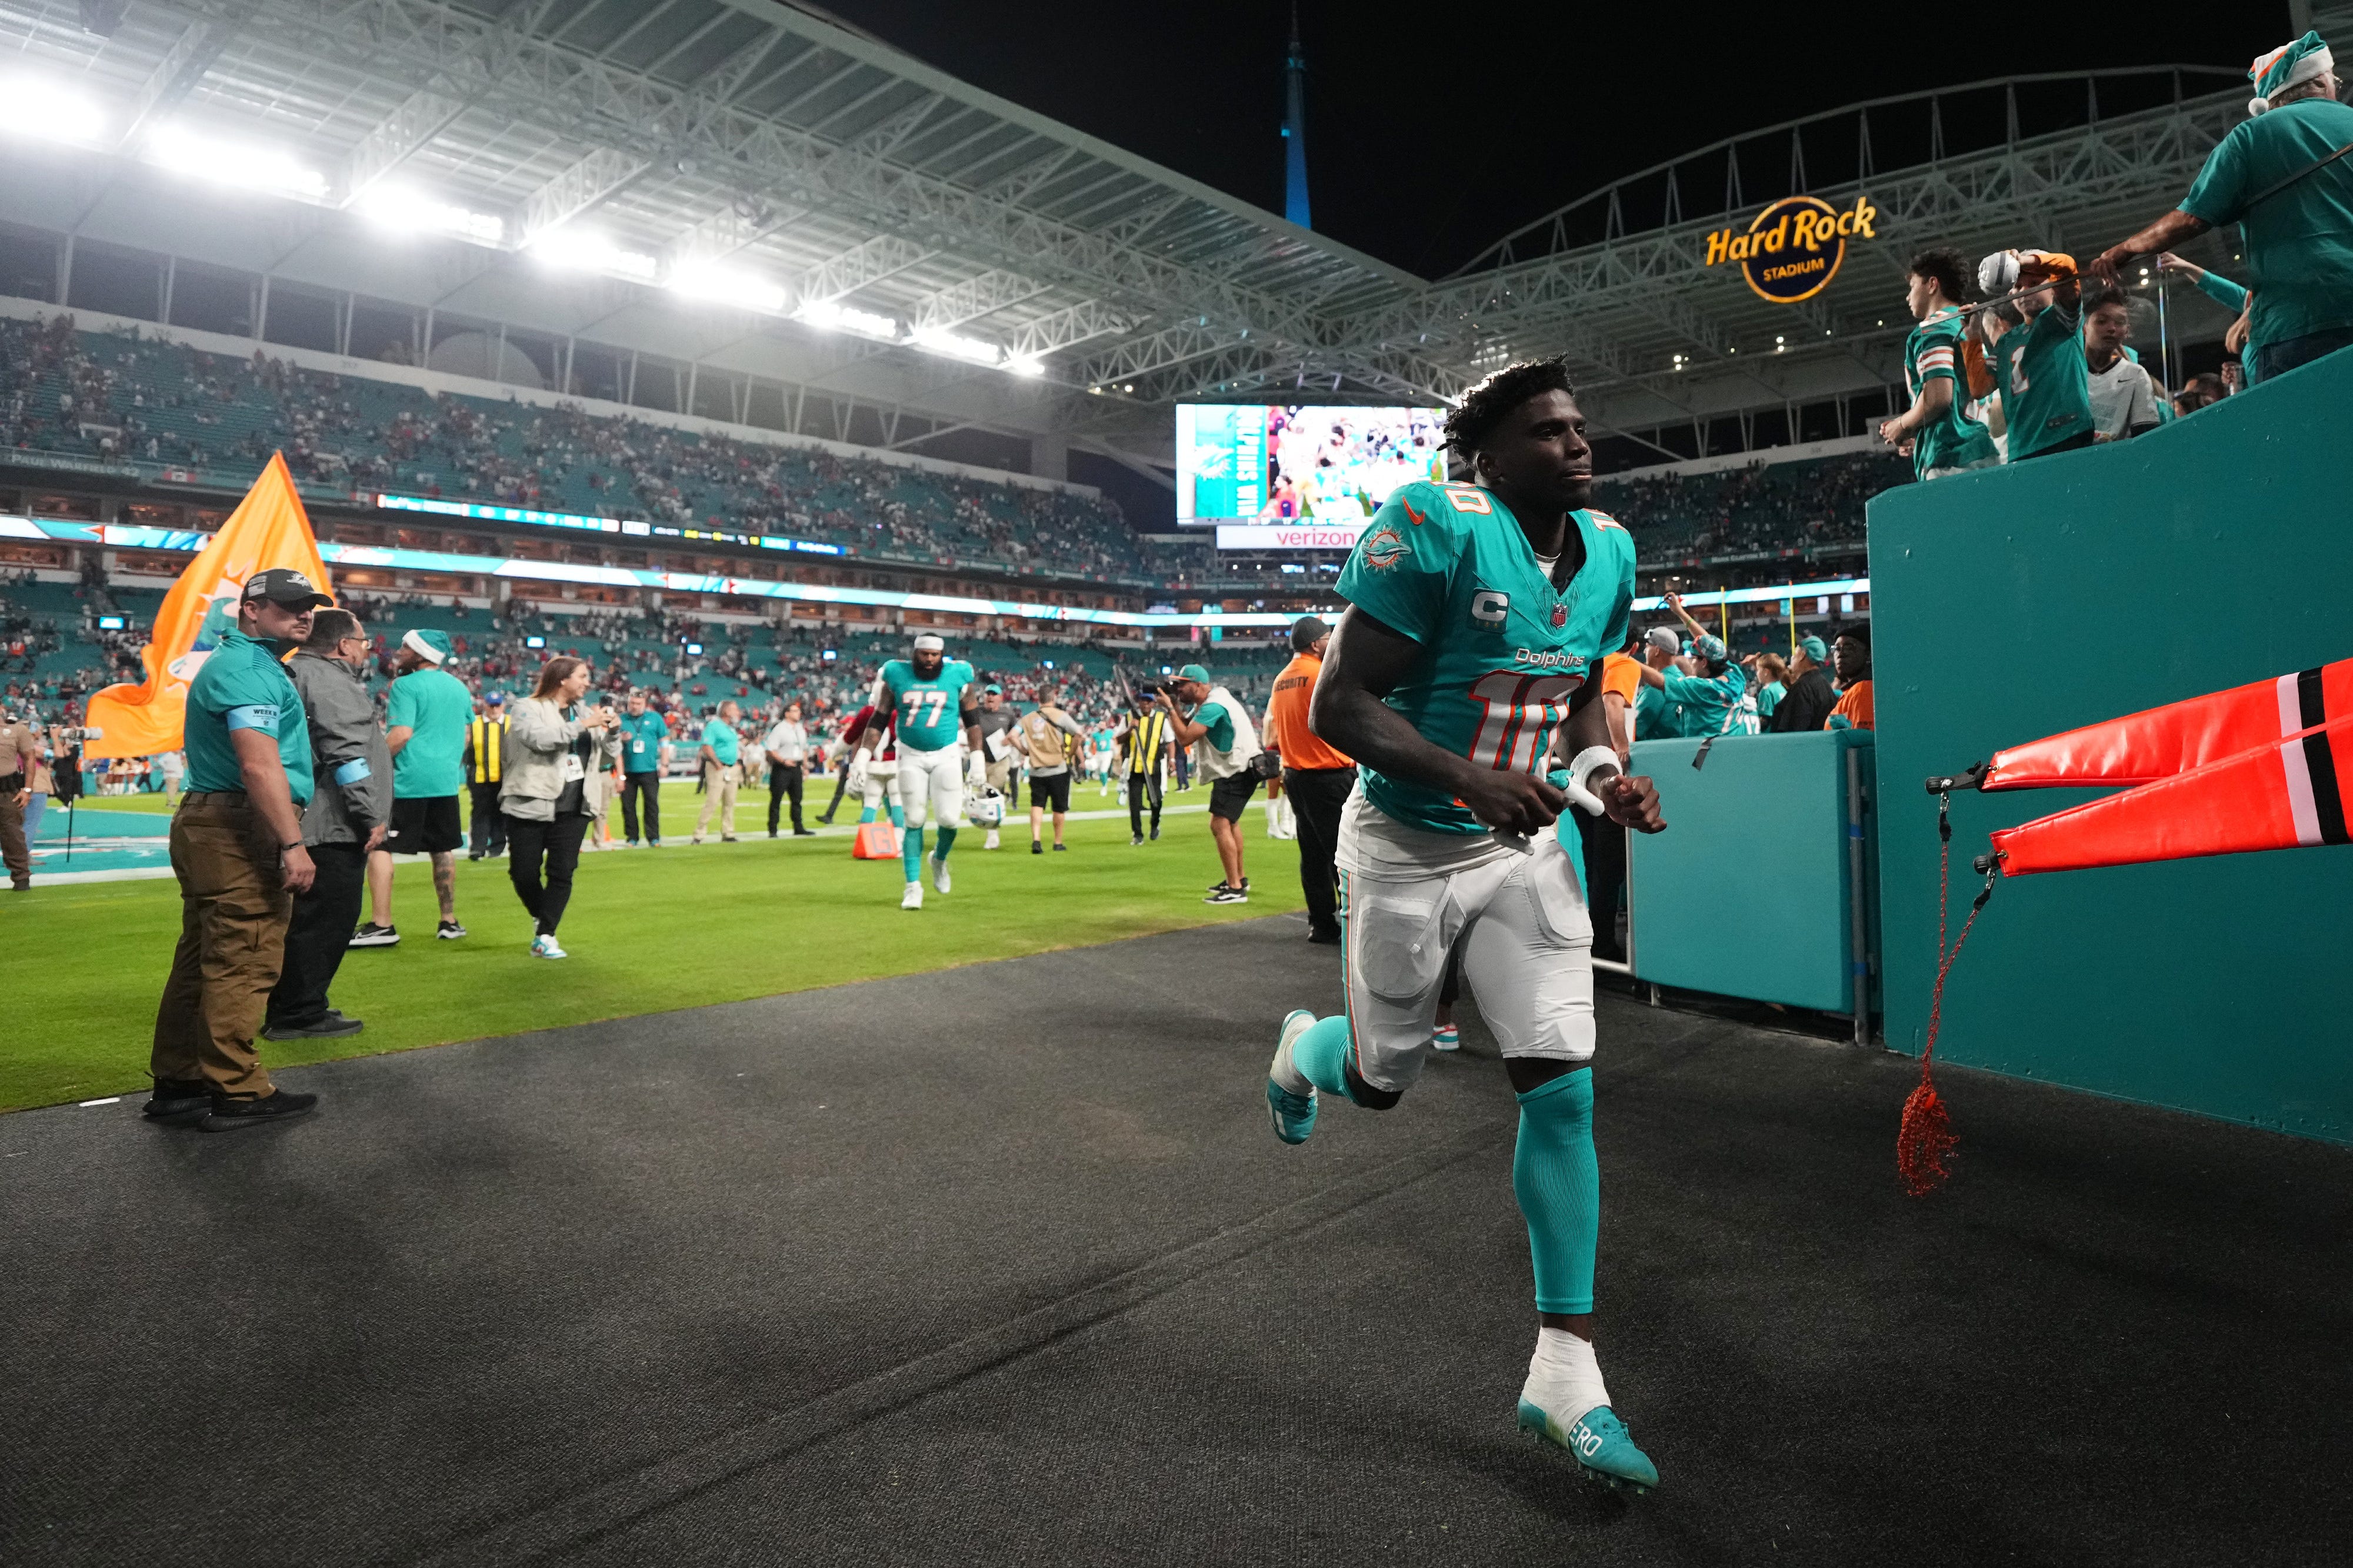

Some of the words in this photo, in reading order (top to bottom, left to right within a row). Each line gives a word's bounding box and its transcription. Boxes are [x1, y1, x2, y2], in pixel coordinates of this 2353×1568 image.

[1706, 214, 1789, 266] Hard
[1793, 196, 1877, 252] Rock
[1763, 258, 1825, 282] STADIUM
[1277, 527, 1355, 545] verizon
[1472, 592, 1508, 622] C
[1515, 648, 1585, 670] Dolphins
[902, 690, 948, 728] 77
[870, 826, 892, 853] G
